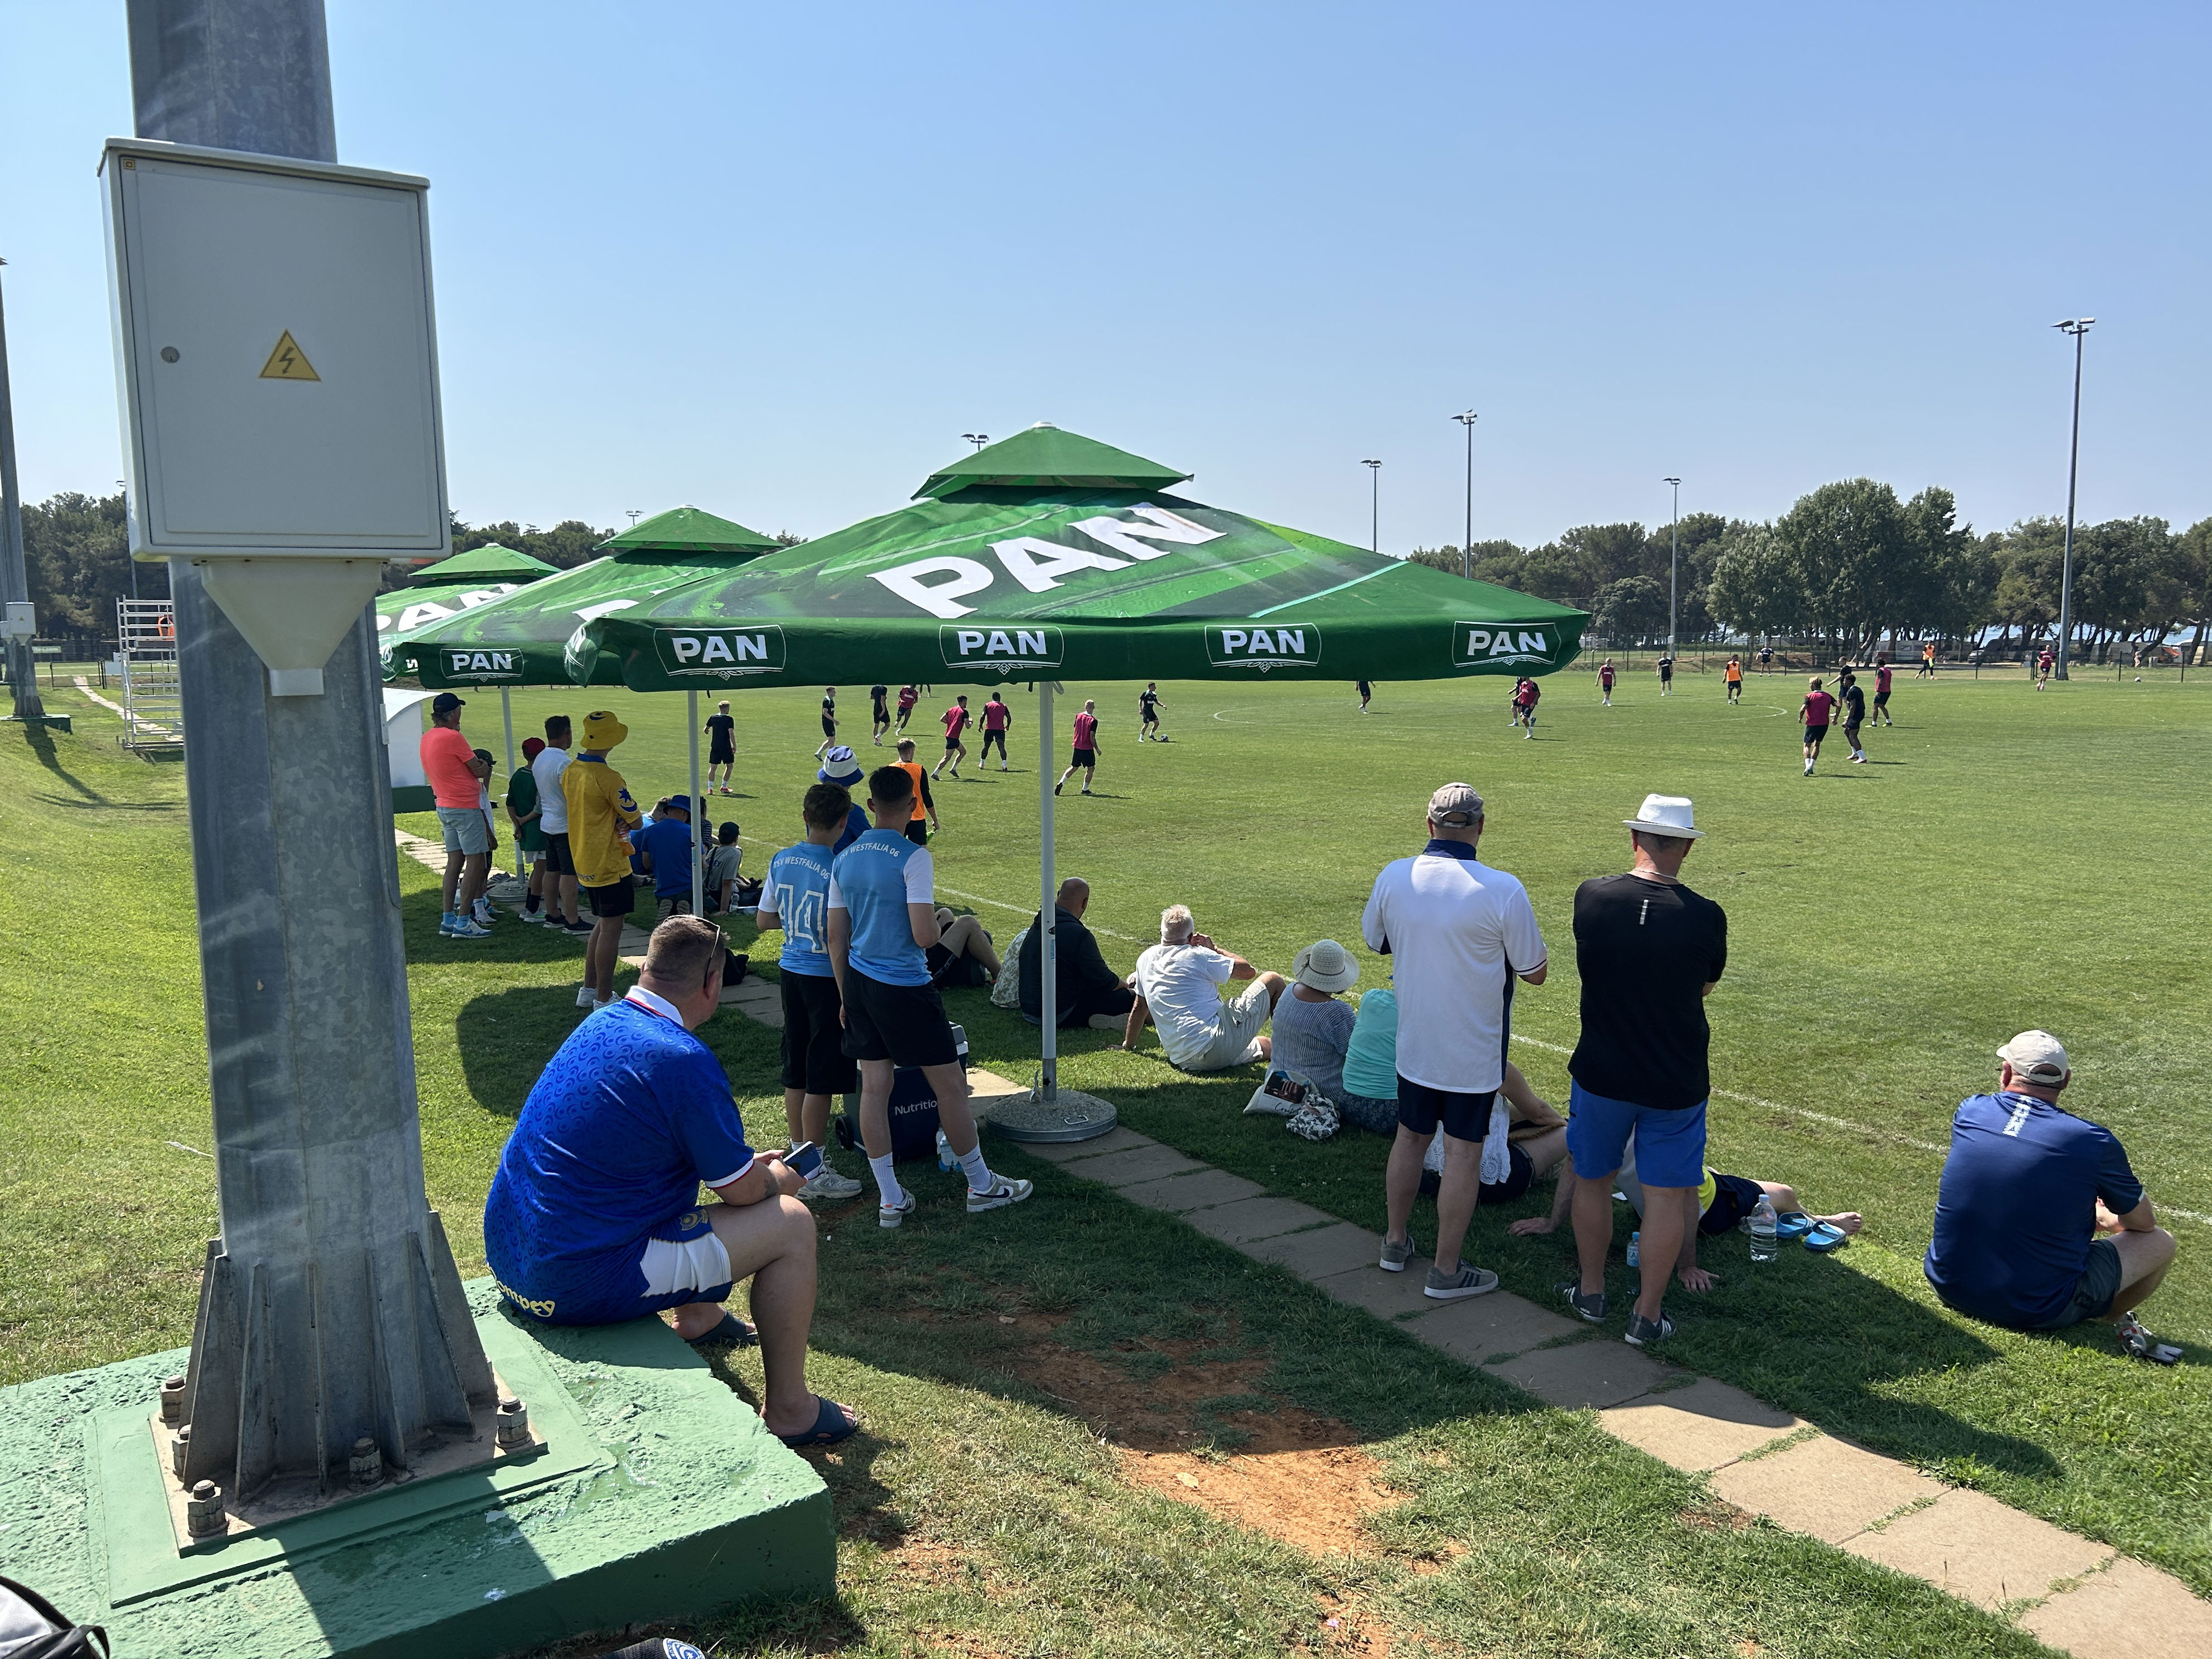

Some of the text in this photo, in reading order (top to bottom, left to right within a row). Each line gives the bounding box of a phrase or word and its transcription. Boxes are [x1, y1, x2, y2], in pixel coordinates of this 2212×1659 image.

[866, 502, 1227, 619] PAN
[672, 635, 768, 663] PAN
[957, 631, 1048, 655] PAN
[1221, 630, 1305, 654] PAN
[1467, 631, 1547, 655] PAN
[451, 653, 512, 671] PAN
[850, 843, 889, 853] WESTFALIA
[889, 848, 900, 857] 06
[774, 856, 831, 880] TSV WESTFALIA 06
[894, 1099, 937, 1116] Nutritio
